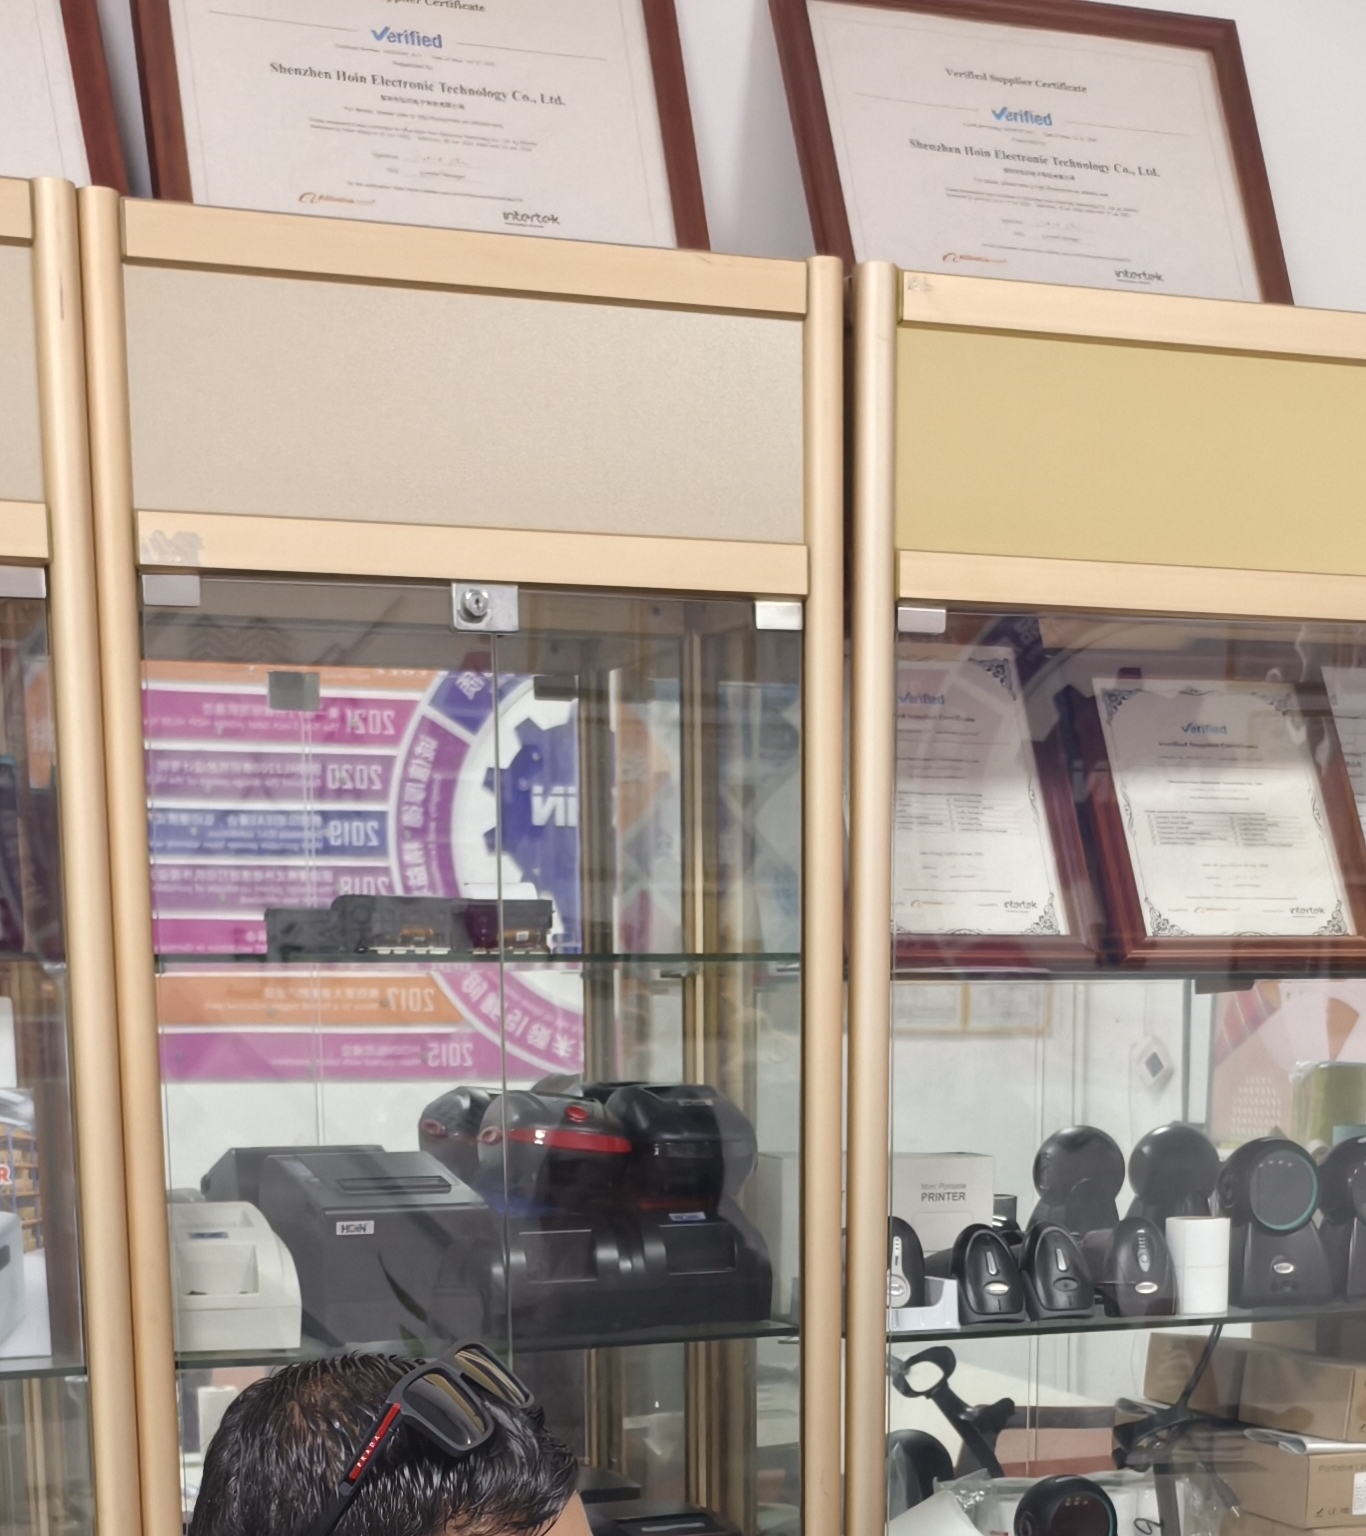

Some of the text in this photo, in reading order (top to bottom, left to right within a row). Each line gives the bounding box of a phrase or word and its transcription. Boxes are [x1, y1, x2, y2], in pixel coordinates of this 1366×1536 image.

[371, 26, 443, 49] Verified
[270, 62, 332, 81] Shenzhen
[370, 74, 435, 94] Electronic
[439, 82, 509, 103] Technology
[991, 106, 1053, 127] Verified
[920, 1191, 966, 1202] PRINTER
[355, 1433, 381, 1469] PRADA
